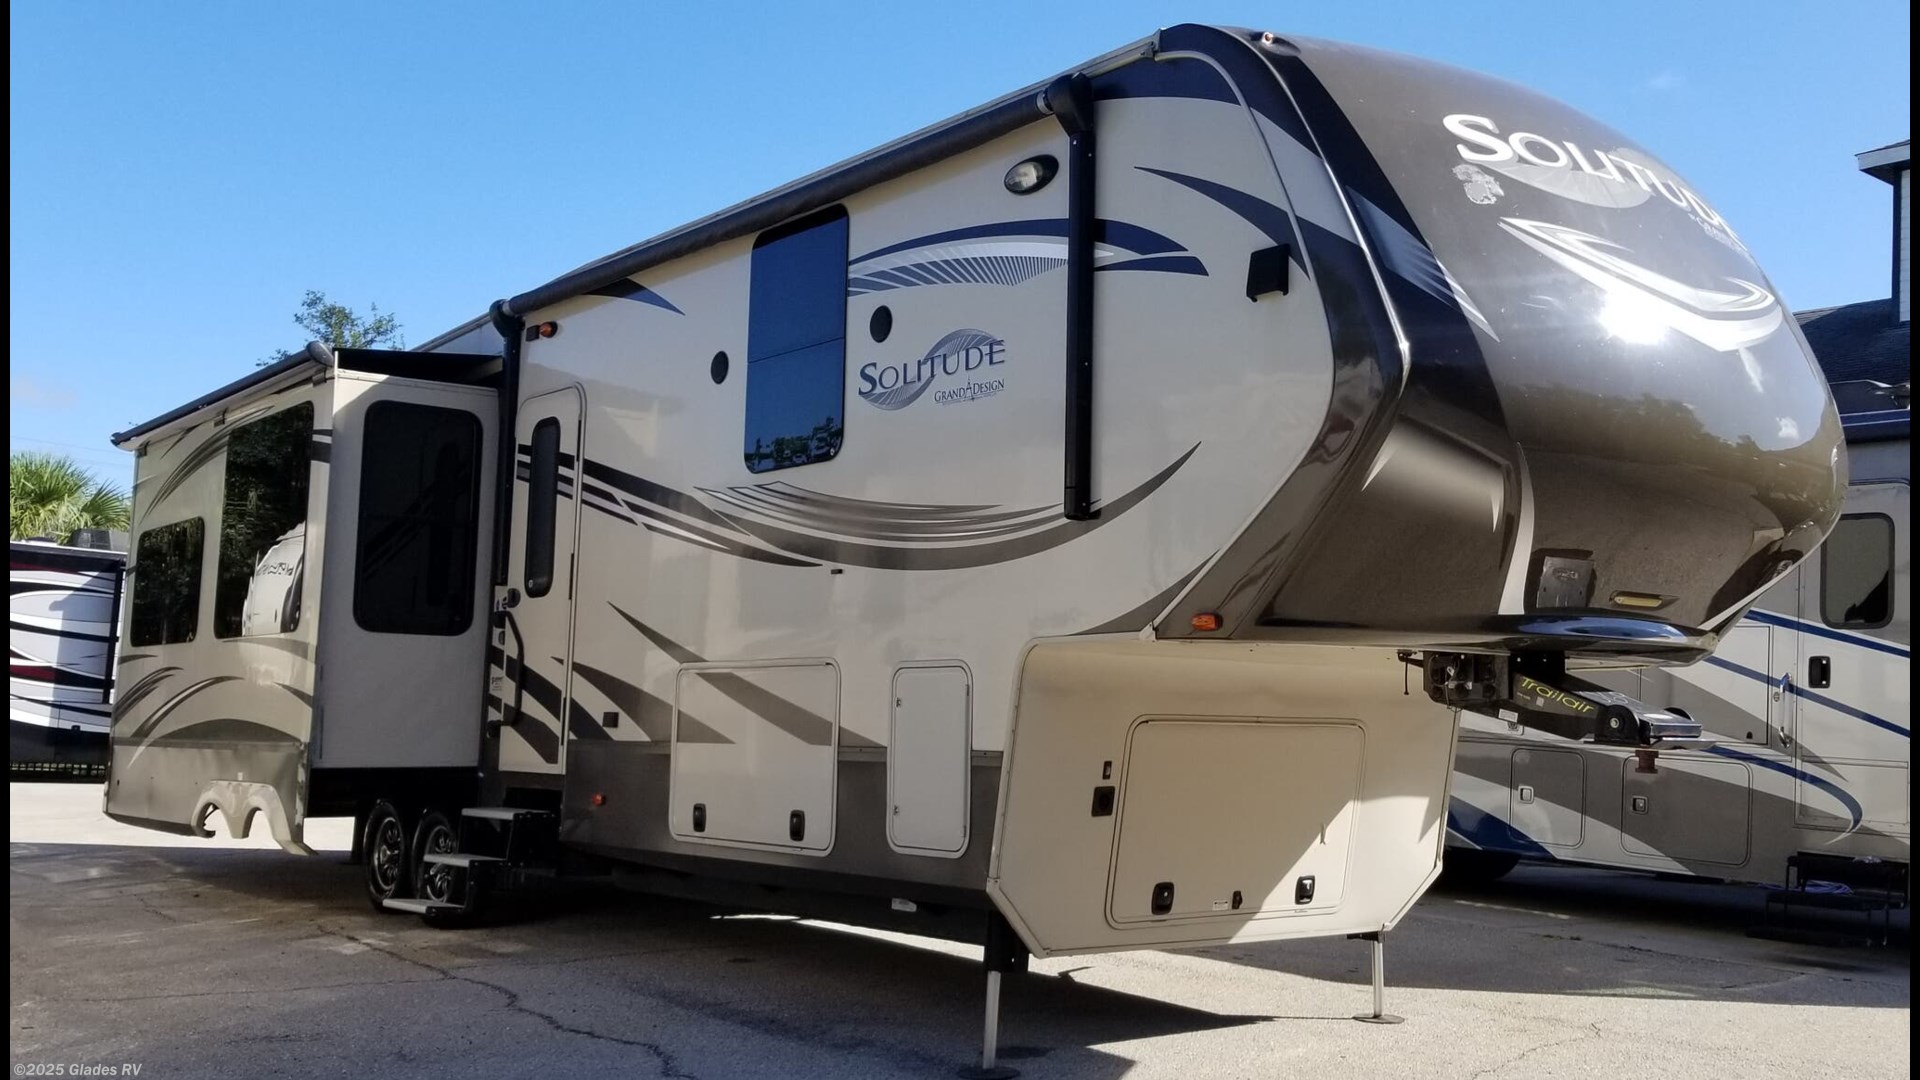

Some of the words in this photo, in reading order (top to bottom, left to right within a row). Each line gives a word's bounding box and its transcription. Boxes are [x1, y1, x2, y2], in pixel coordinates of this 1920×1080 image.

[1442, 113, 1748, 251] SOLITUD
[858, 339, 1006, 396] SOLITUDE
[1520, 677, 1595, 714] Trailair
